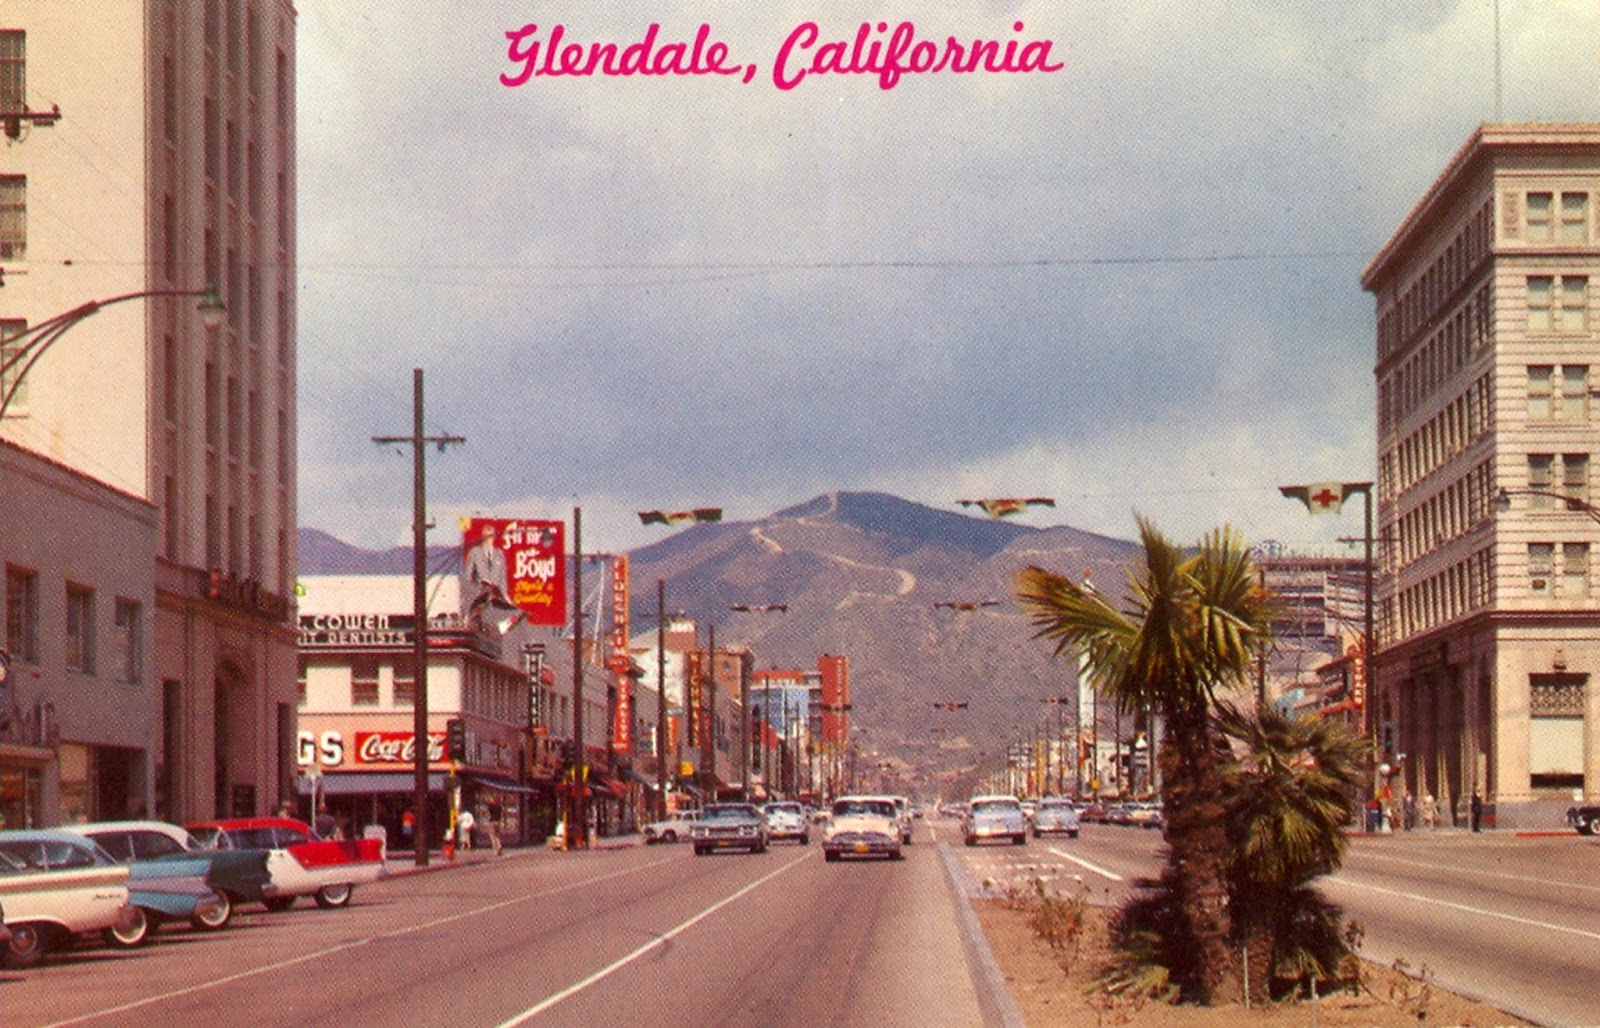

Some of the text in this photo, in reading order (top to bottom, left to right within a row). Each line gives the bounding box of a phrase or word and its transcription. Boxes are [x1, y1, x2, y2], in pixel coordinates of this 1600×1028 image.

[513, 550, 556, 582] Boyd
[313, 614, 389, 629] COWEN
[329, 632, 407, 645] DENTISTS
